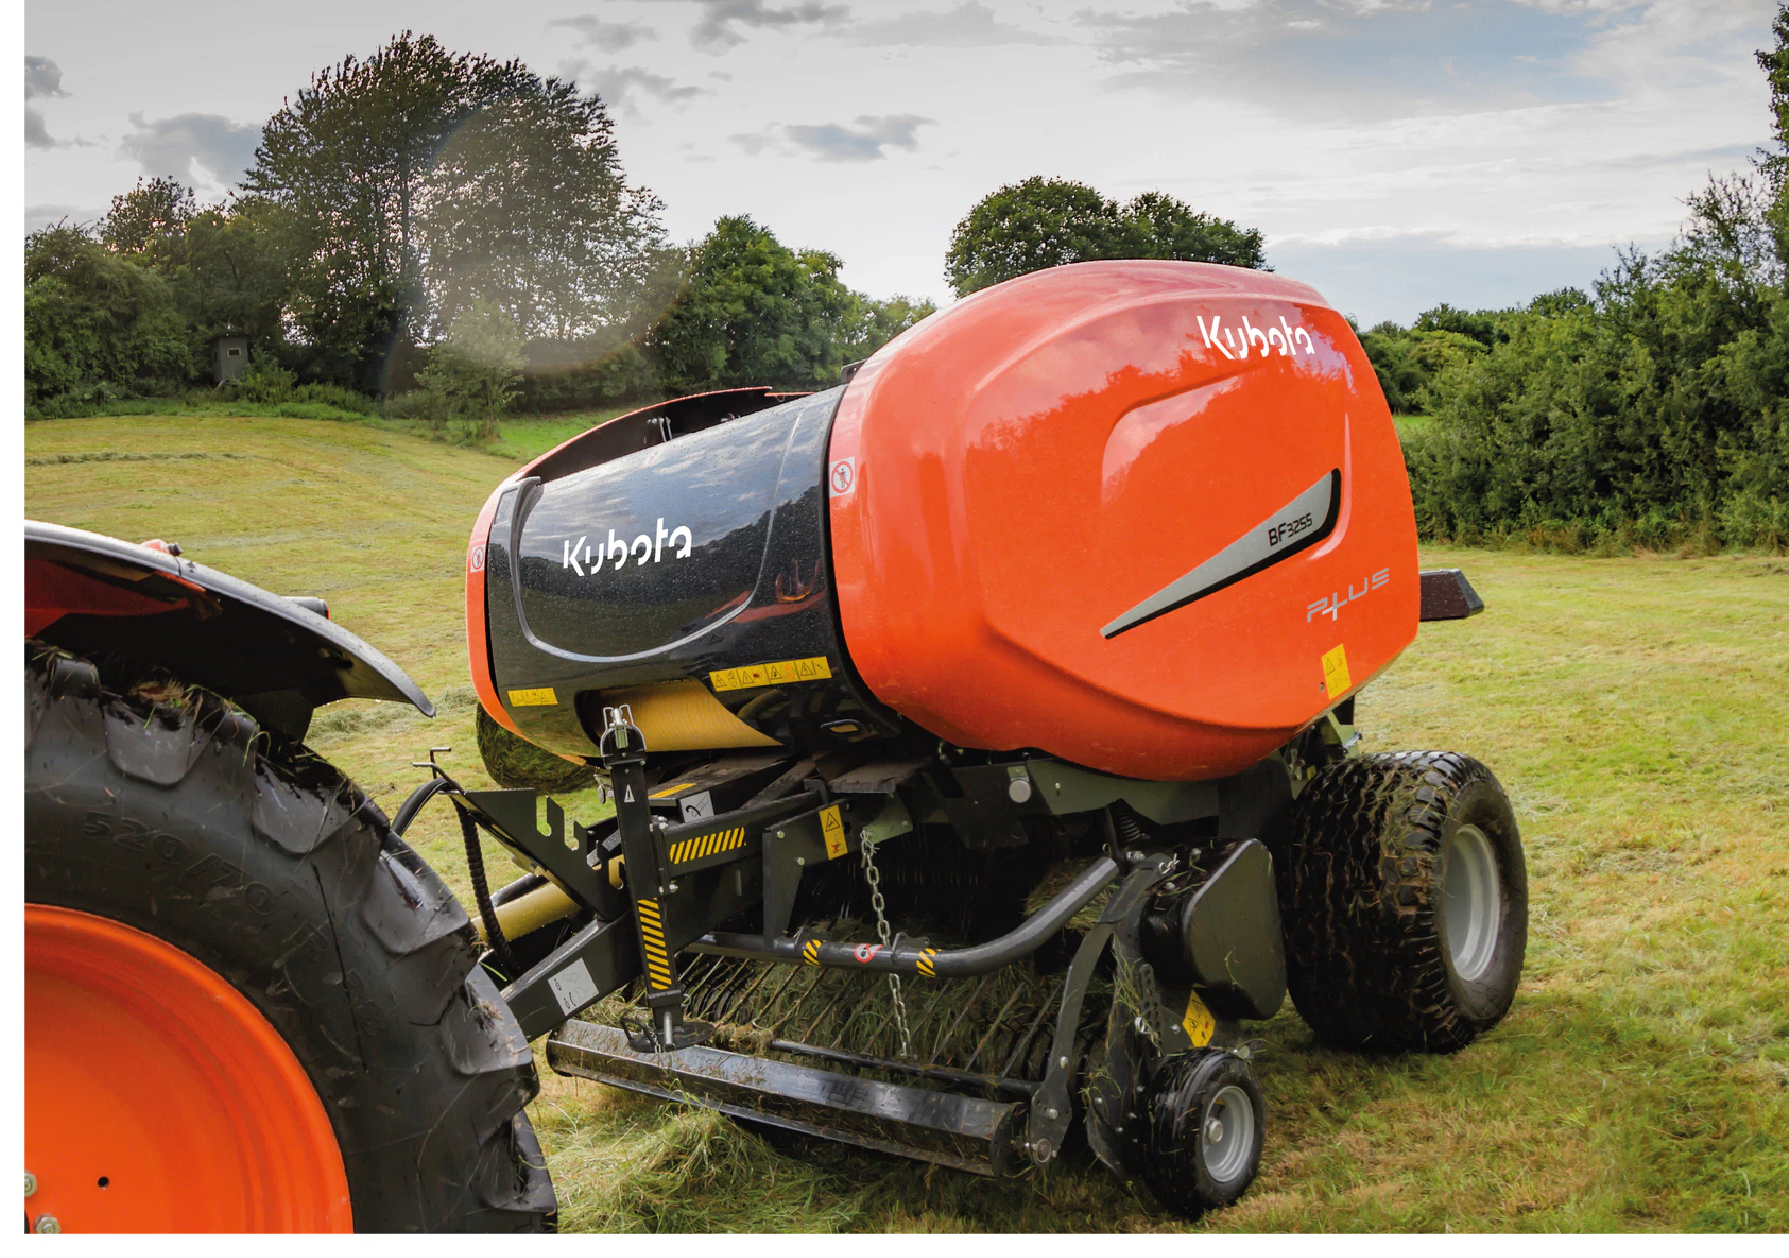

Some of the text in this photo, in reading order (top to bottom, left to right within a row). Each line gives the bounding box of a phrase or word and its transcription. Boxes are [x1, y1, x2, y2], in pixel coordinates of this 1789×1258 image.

[1196, 315, 1316, 360] Kubota
[563, 517, 692, 577] Kubota
[1307, 567, 1390, 623] PLUS
